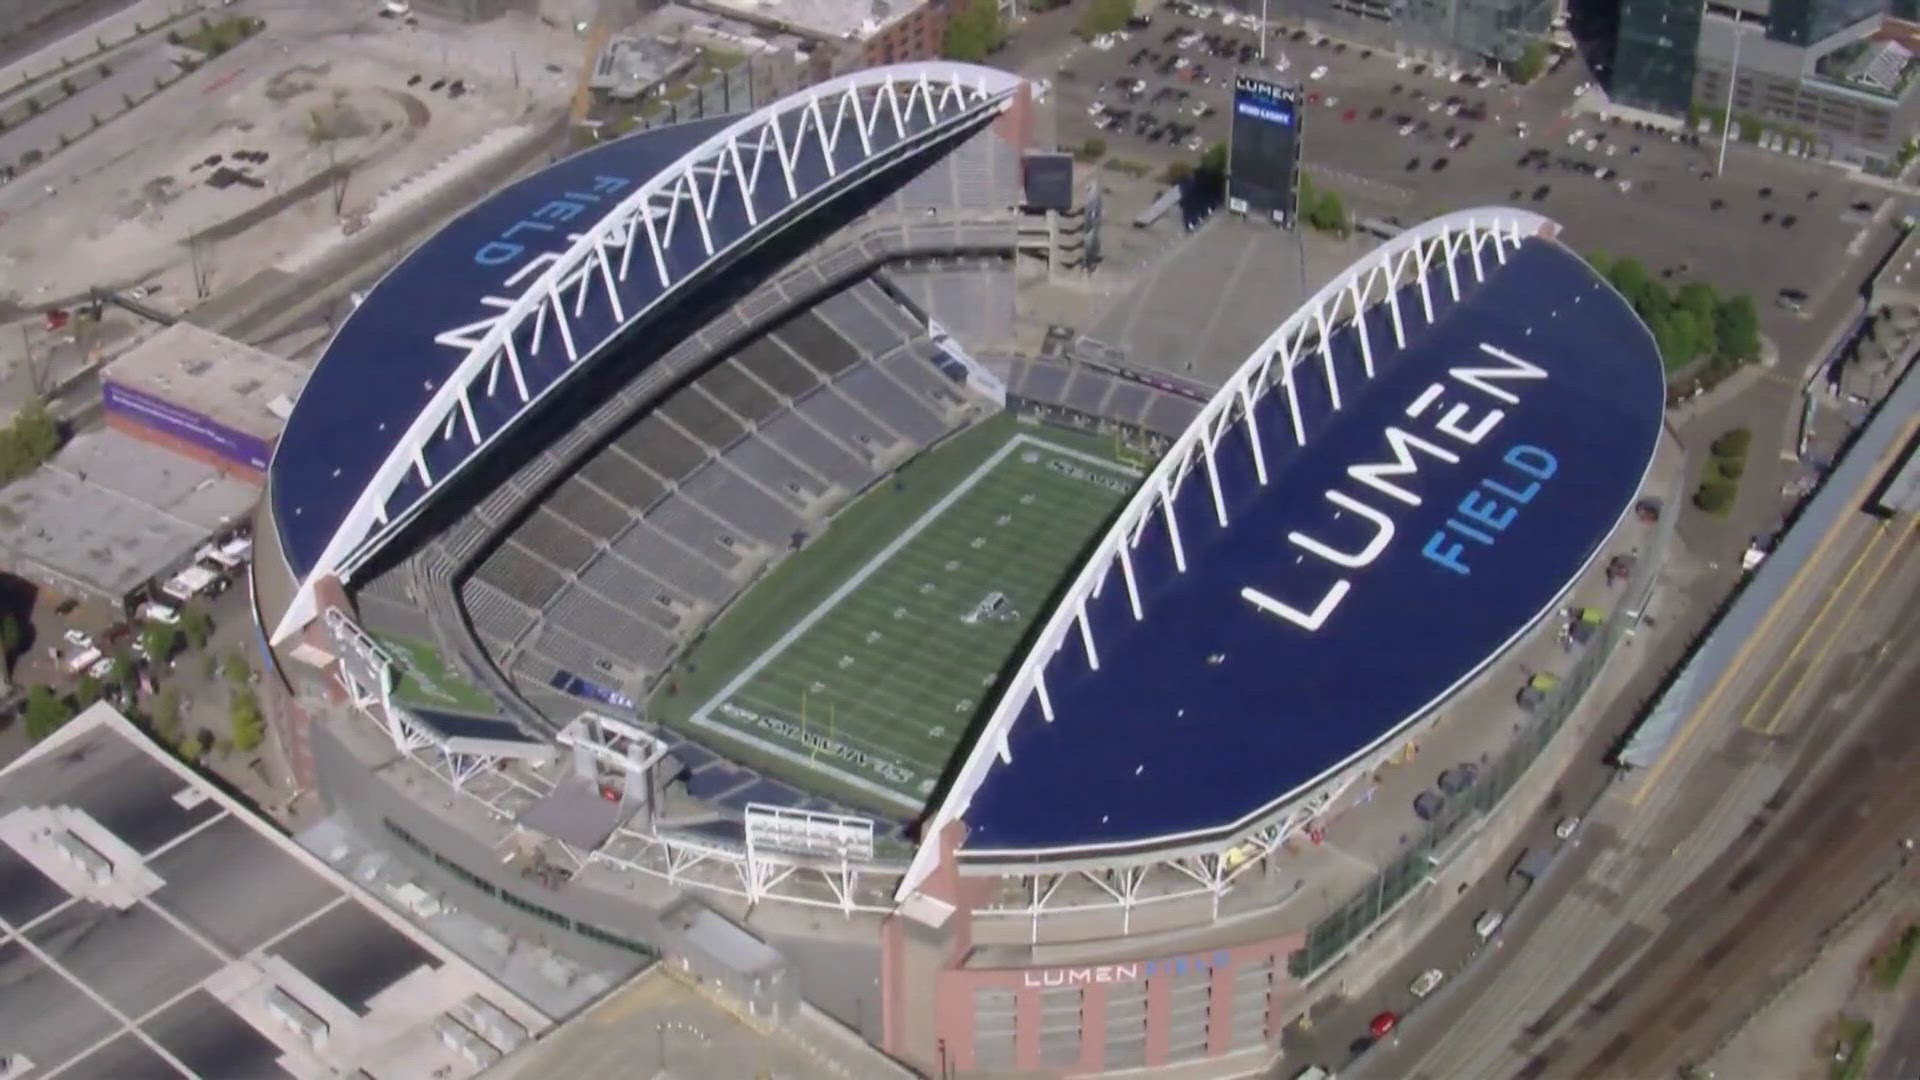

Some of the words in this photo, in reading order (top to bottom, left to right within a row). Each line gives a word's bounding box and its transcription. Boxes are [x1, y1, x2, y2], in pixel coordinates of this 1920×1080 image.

[1236, 79, 1295, 101] LUMEN
[474, 175, 630, 265] FIELD
[1241, 343, 1548, 631] LUMEN
[1422, 444, 1558, 575] FIELD
[1024, 963, 1138, 987] LUMEN
